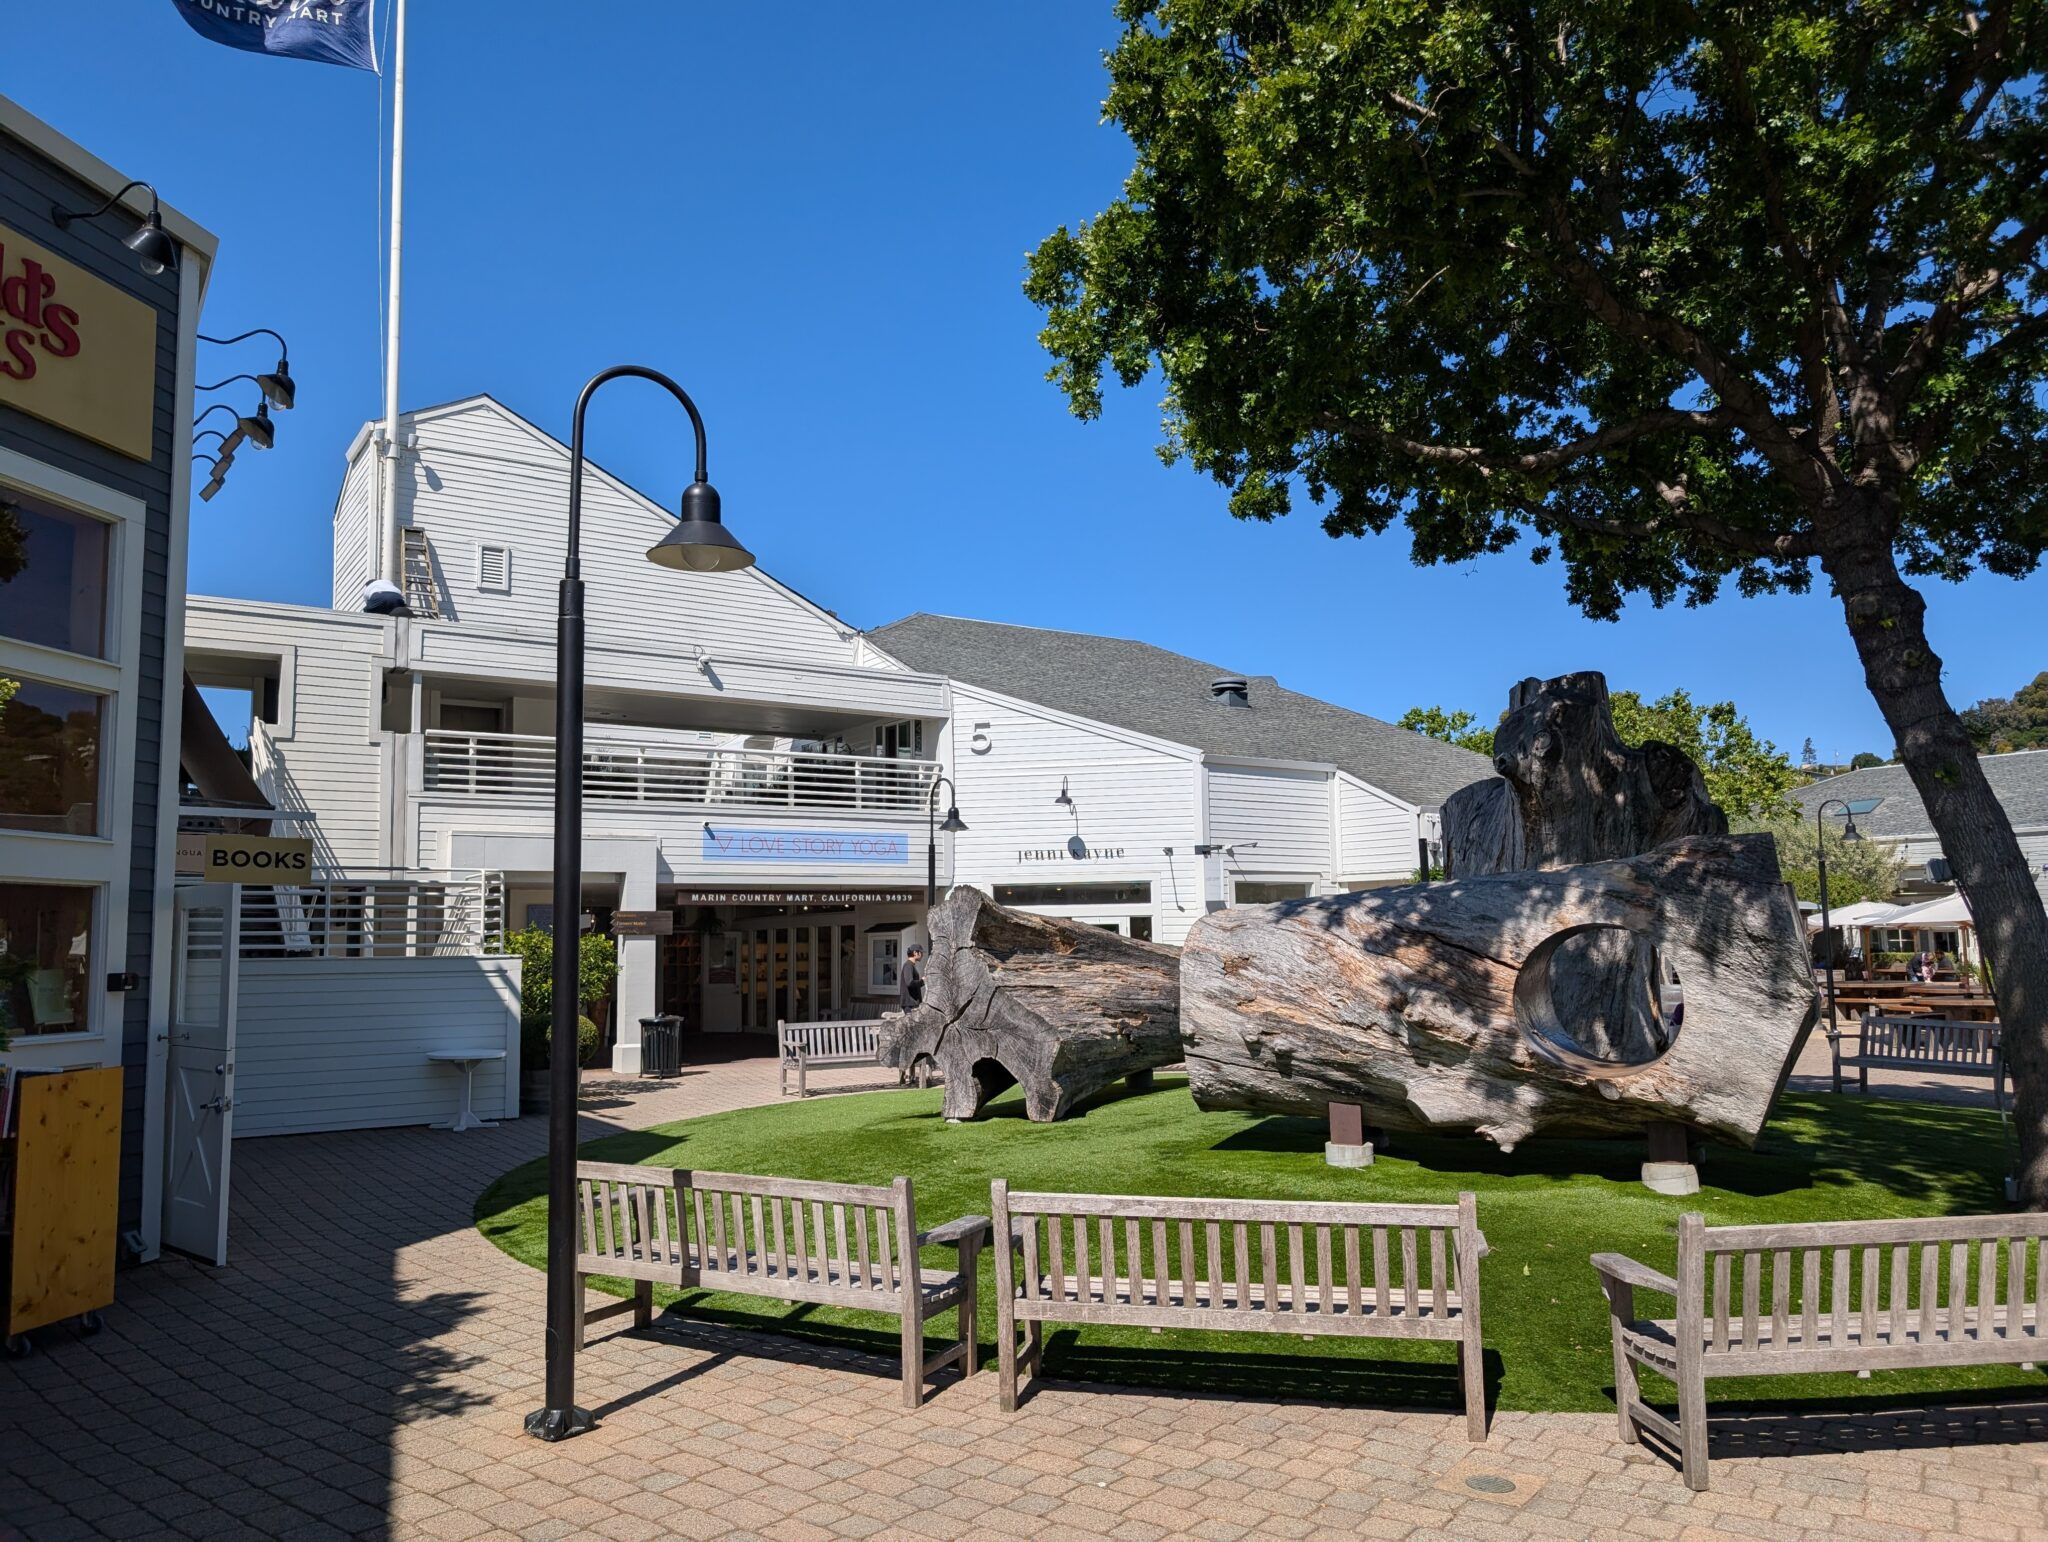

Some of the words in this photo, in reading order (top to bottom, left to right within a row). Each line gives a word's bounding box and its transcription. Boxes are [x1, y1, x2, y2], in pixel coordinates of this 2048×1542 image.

[970, 720, 992, 756] 5
[741, 836, 785, 854] LOVE
[792, 836, 845, 855] STORY
[851, 838, 898, 856] YOGA
[212, 849, 306, 870] BOOKS
[1017, 849, 1064, 865] jenni
[691, 893, 727, 902] MARIN
[731, 893, 782, 902] COUNTRY
[786, 894, 817, 903] MART,
[821, 894, 882, 902] CALIFORNIA
[885, 894, 913, 902] 94939
